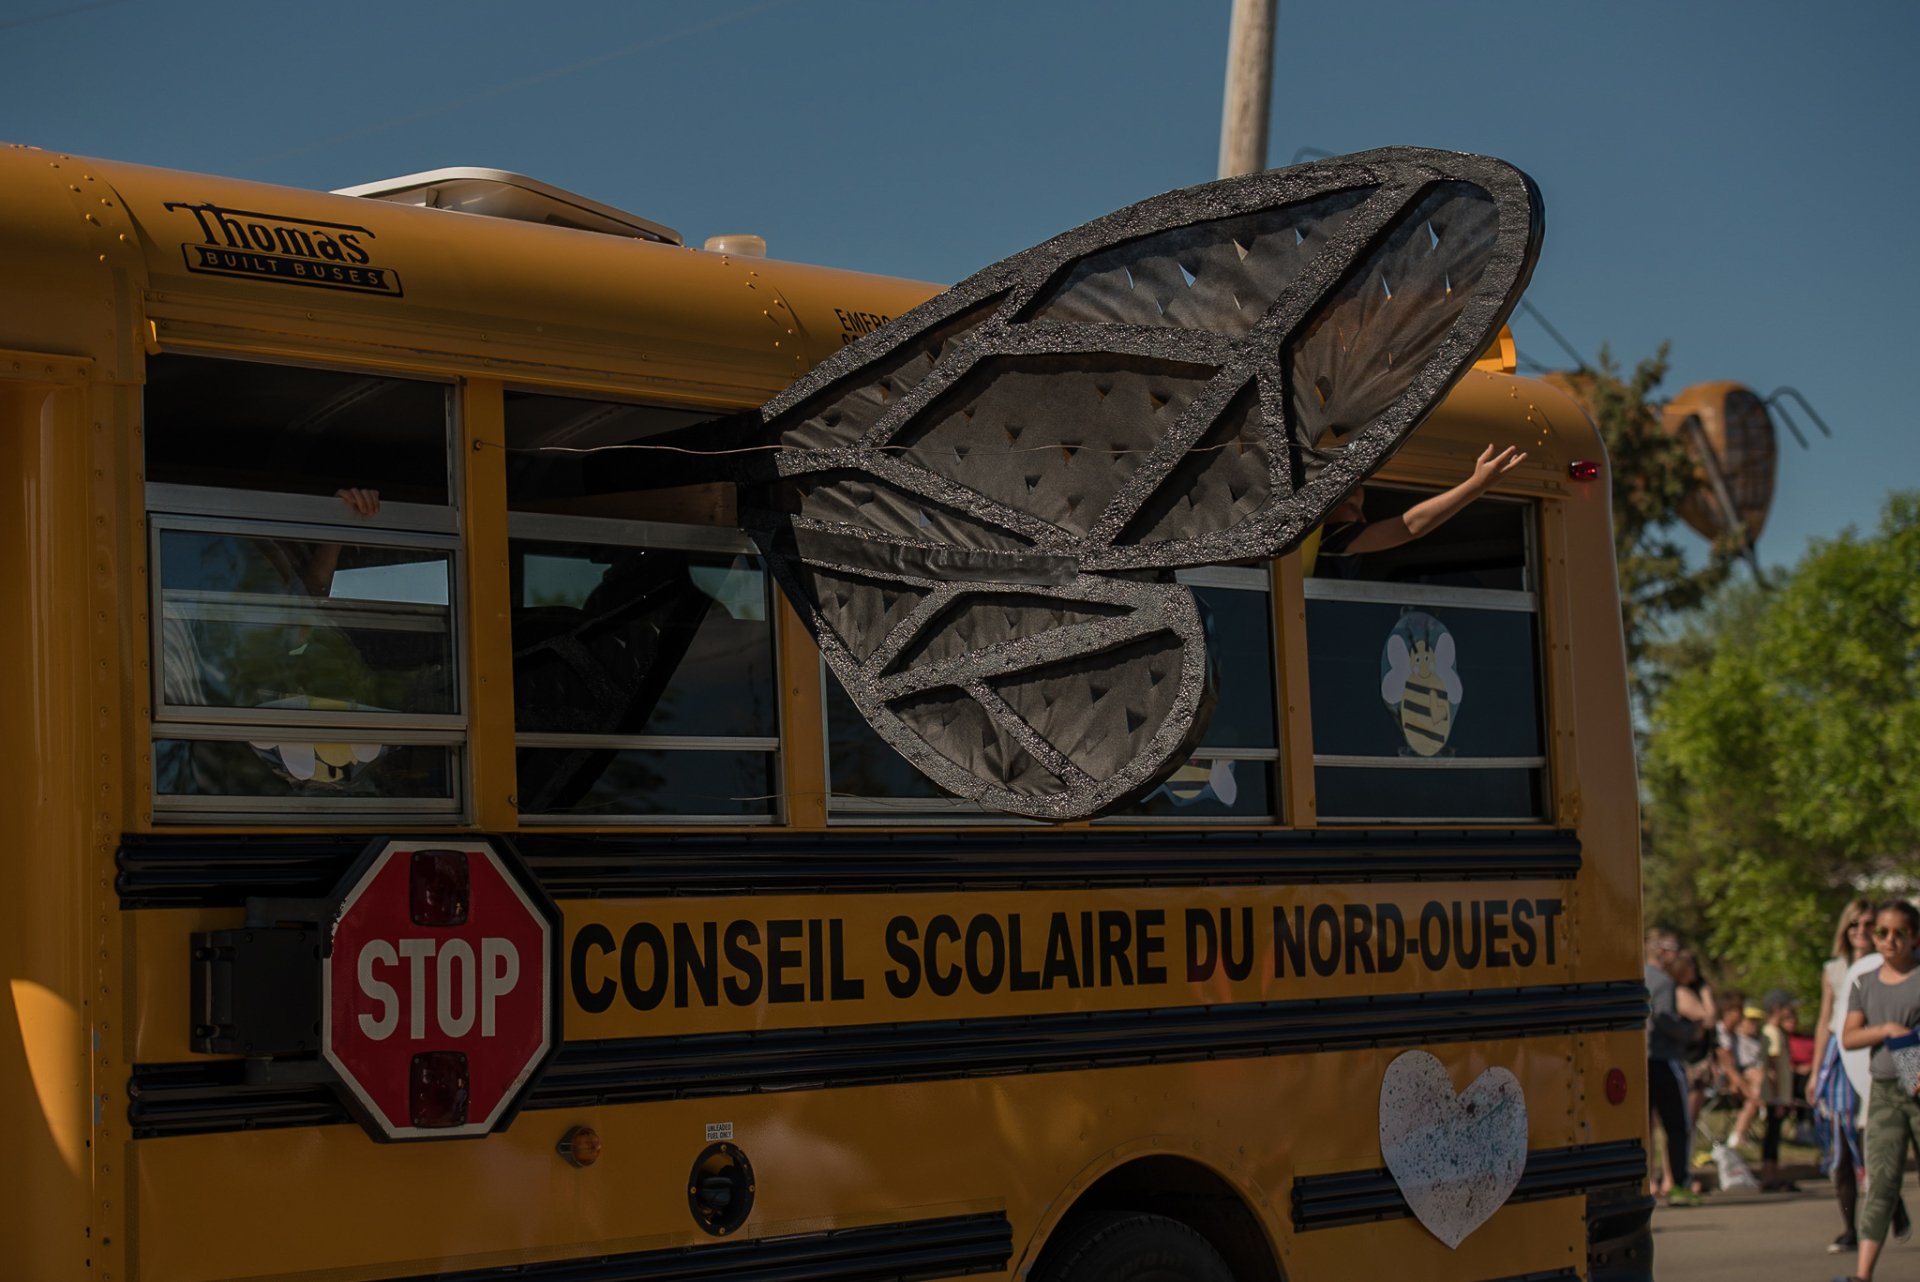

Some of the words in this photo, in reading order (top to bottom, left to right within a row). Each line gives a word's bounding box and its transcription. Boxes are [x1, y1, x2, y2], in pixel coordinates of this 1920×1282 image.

[163, 202, 376, 265] Thomas
[205, 252, 278, 273] BUILT
[295, 264, 379, 285] BUSES
[570, 918, 865, 1014] CONSEIL
[885, 909, 1168, 999] SCOLAIRE
[1185, 907, 1254, 983] DU
[1273, 899, 1563, 979] NORD-OUEST
[357, 937, 520, 1041] STOP
[707, 1123, 732, 1132] UNLEADED
